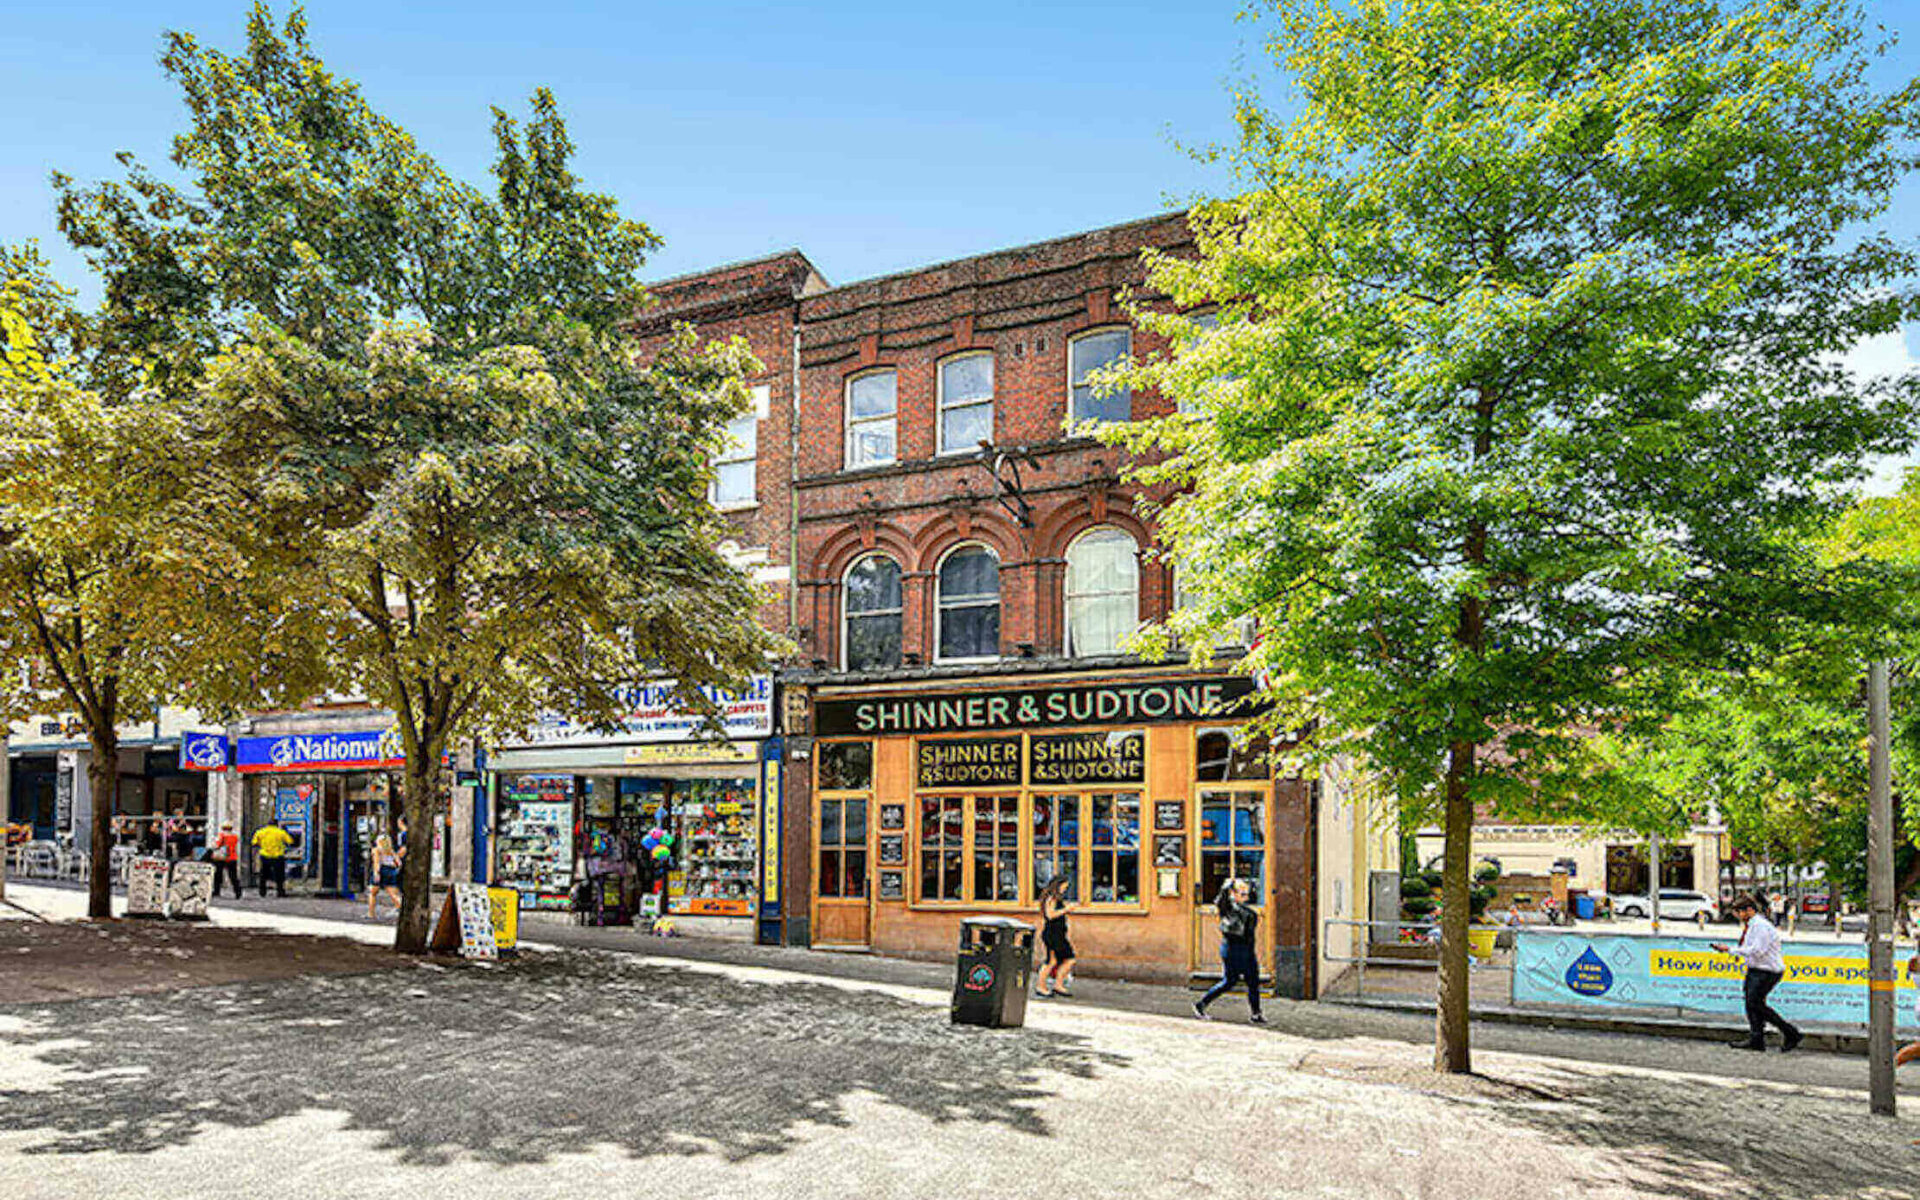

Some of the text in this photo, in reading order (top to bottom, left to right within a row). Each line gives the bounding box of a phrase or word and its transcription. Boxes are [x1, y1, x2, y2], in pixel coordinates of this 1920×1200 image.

[856, 685, 1223, 731] SHINNER & SUDTONE
[294, 732, 406, 760] Nationw
[920, 742, 1018, 765] SHINNER
[1033, 738, 1141, 762] SHINNER
[1658, 957, 1704, 970] How
[1709, 959, 1749, 974] long
[1790, 965, 1827, 978] you
